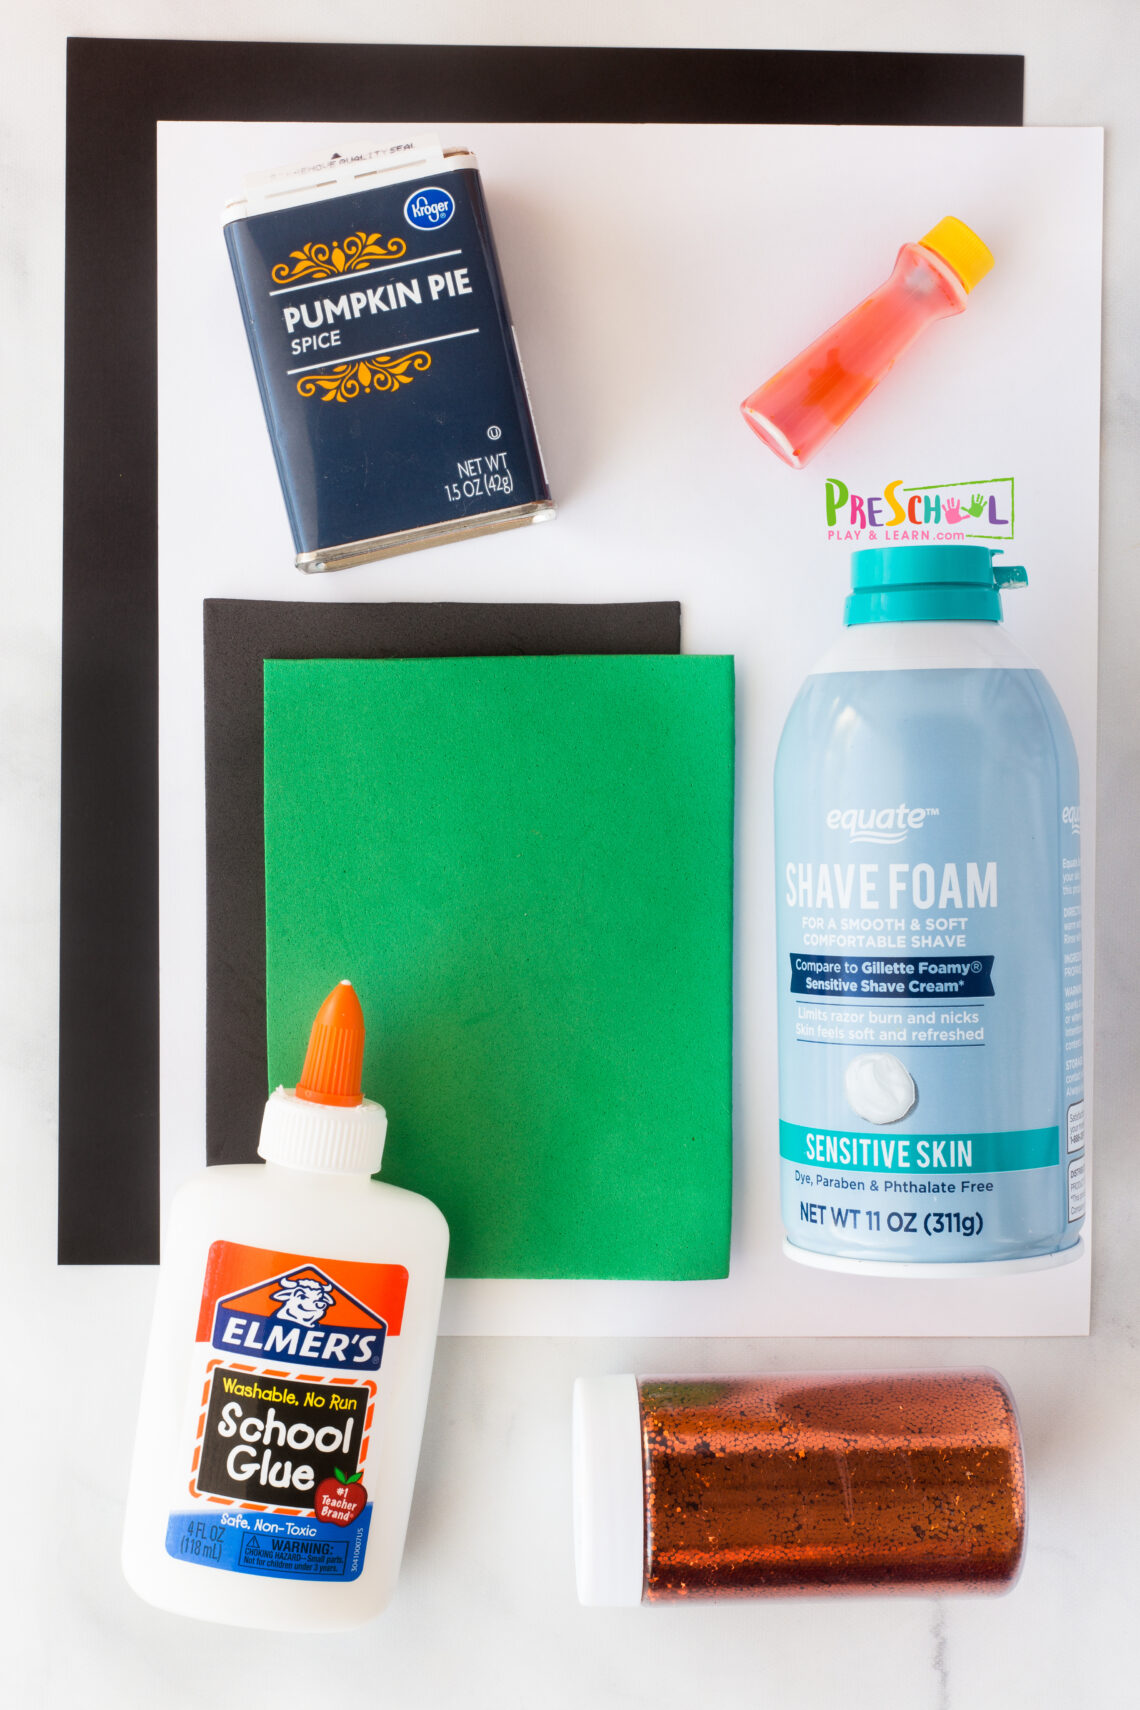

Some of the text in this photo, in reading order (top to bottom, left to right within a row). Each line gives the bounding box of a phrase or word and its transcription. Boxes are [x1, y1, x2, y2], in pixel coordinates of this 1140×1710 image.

[283, 268, 473, 333] PUMPKIN PIE
[291, 330, 342, 355] SPICE
[457, 452, 508, 480] NET WT
[444, 471, 514, 502] 1.5 OZ (42g)
[786, 862, 998, 910] SHAVE FOAM
[802, 917, 968, 931] FOR A SMOOTH & SOFT
[803, 934, 966, 948] COMFORTABLE SHAVE
[795, 958, 841, 974] Compare
[844, 961, 858, 973] to
[861, 961, 915, 975] Gillette
[805, 977, 858, 992] Sensitive
[861, 981, 905, 992] Shave
[798, 1007, 980, 1025] Limits razor burn and nicks
[795, 1023, 985, 1041] Skin feels soft and refreshed
[806, 1133, 973, 1169] SENSITIVE SKIN
[795, 1170, 994, 1193] Dye, Paraben & Phthalate Free
[800, 1201, 984, 1237] NET WT 11 OZ (311g)
[303, 1392, 326, 1407] No
[329, 1394, 357, 1411] Run
[217, 1401, 354, 1454] School
[226, 1444, 315, 1491] Glue
[337, 1487, 349, 1498] #1
[322, 1495, 357, 1511] Teacher
[321, 1506, 351, 1522] Brand
[187, 1521, 226, 1543] 4 FL OZ
[254, 1519, 317, 1537] Non-Toxic
[180, 1535, 222, 1563] (118 mL)
[245, 1548, 273, 1559] CHOKING
[271, 1539, 334, 1555] WARNING:
[244, 1556, 255, 1565] Not
[256, 1558, 265, 1566] for
[266, 1559, 292, 1569] children
[294, 1561, 312, 1571] under
